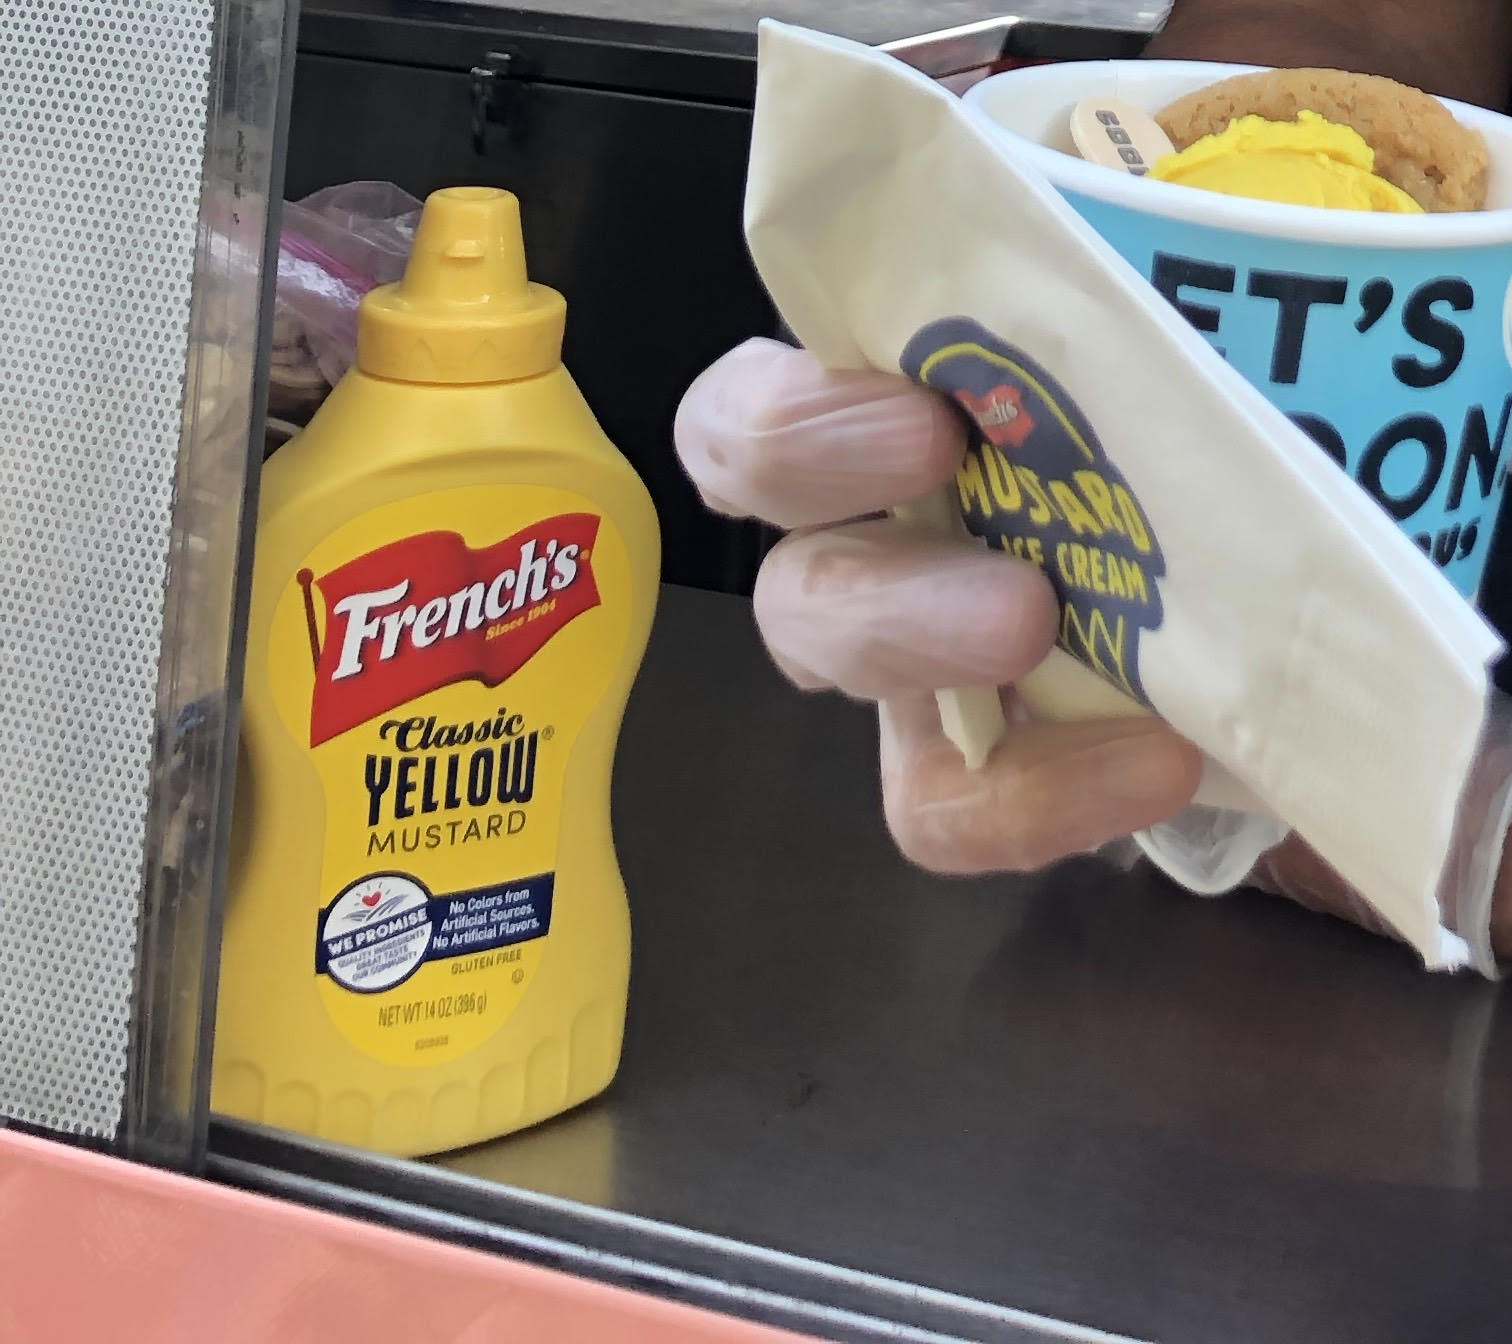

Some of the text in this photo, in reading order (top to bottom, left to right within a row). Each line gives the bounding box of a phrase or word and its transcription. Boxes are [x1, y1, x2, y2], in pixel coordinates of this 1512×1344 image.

[1057, 541, 1148, 604] CREAM
[331, 539, 579, 682] French's
[485, 598, 557, 641] Since 1904
[379, 707, 525, 752] Classic
[365, 730, 538, 827] YELLOW
[367, 810, 527, 857] MUSTARD
[441, 904, 535, 932] Artificial Sources.
[450, 888, 530, 915] No Colors from
[328, 907, 428, 957] WE PROMISE
[433, 917, 540, 950] No Artificial Flavors.
[451, 948, 522, 975] GLUTEN FREE
[378, 1005, 401, 1028] NET
[402, 1000, 422, 1024] WT
[424, 998, 436, 1019] 14
[438, 995, 453, 1019] OZ
